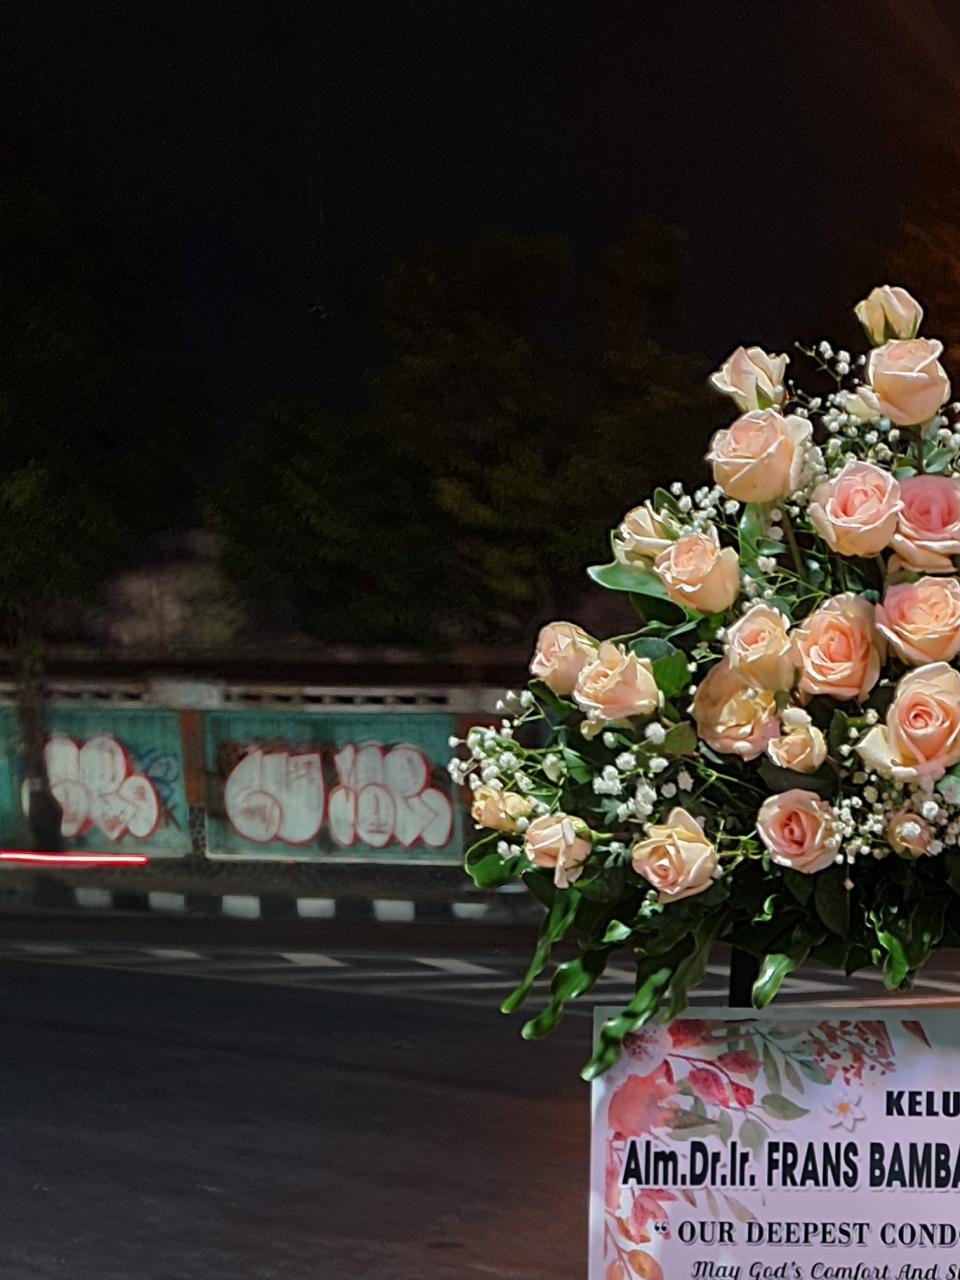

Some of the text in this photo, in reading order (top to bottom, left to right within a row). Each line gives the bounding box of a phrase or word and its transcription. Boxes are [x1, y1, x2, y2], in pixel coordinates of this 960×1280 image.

[767, 1142, 858, 1189] FRANS
[678, 1220, 735, 1244] OUR
[746, 1221, 870, 1245] DEEPEST
